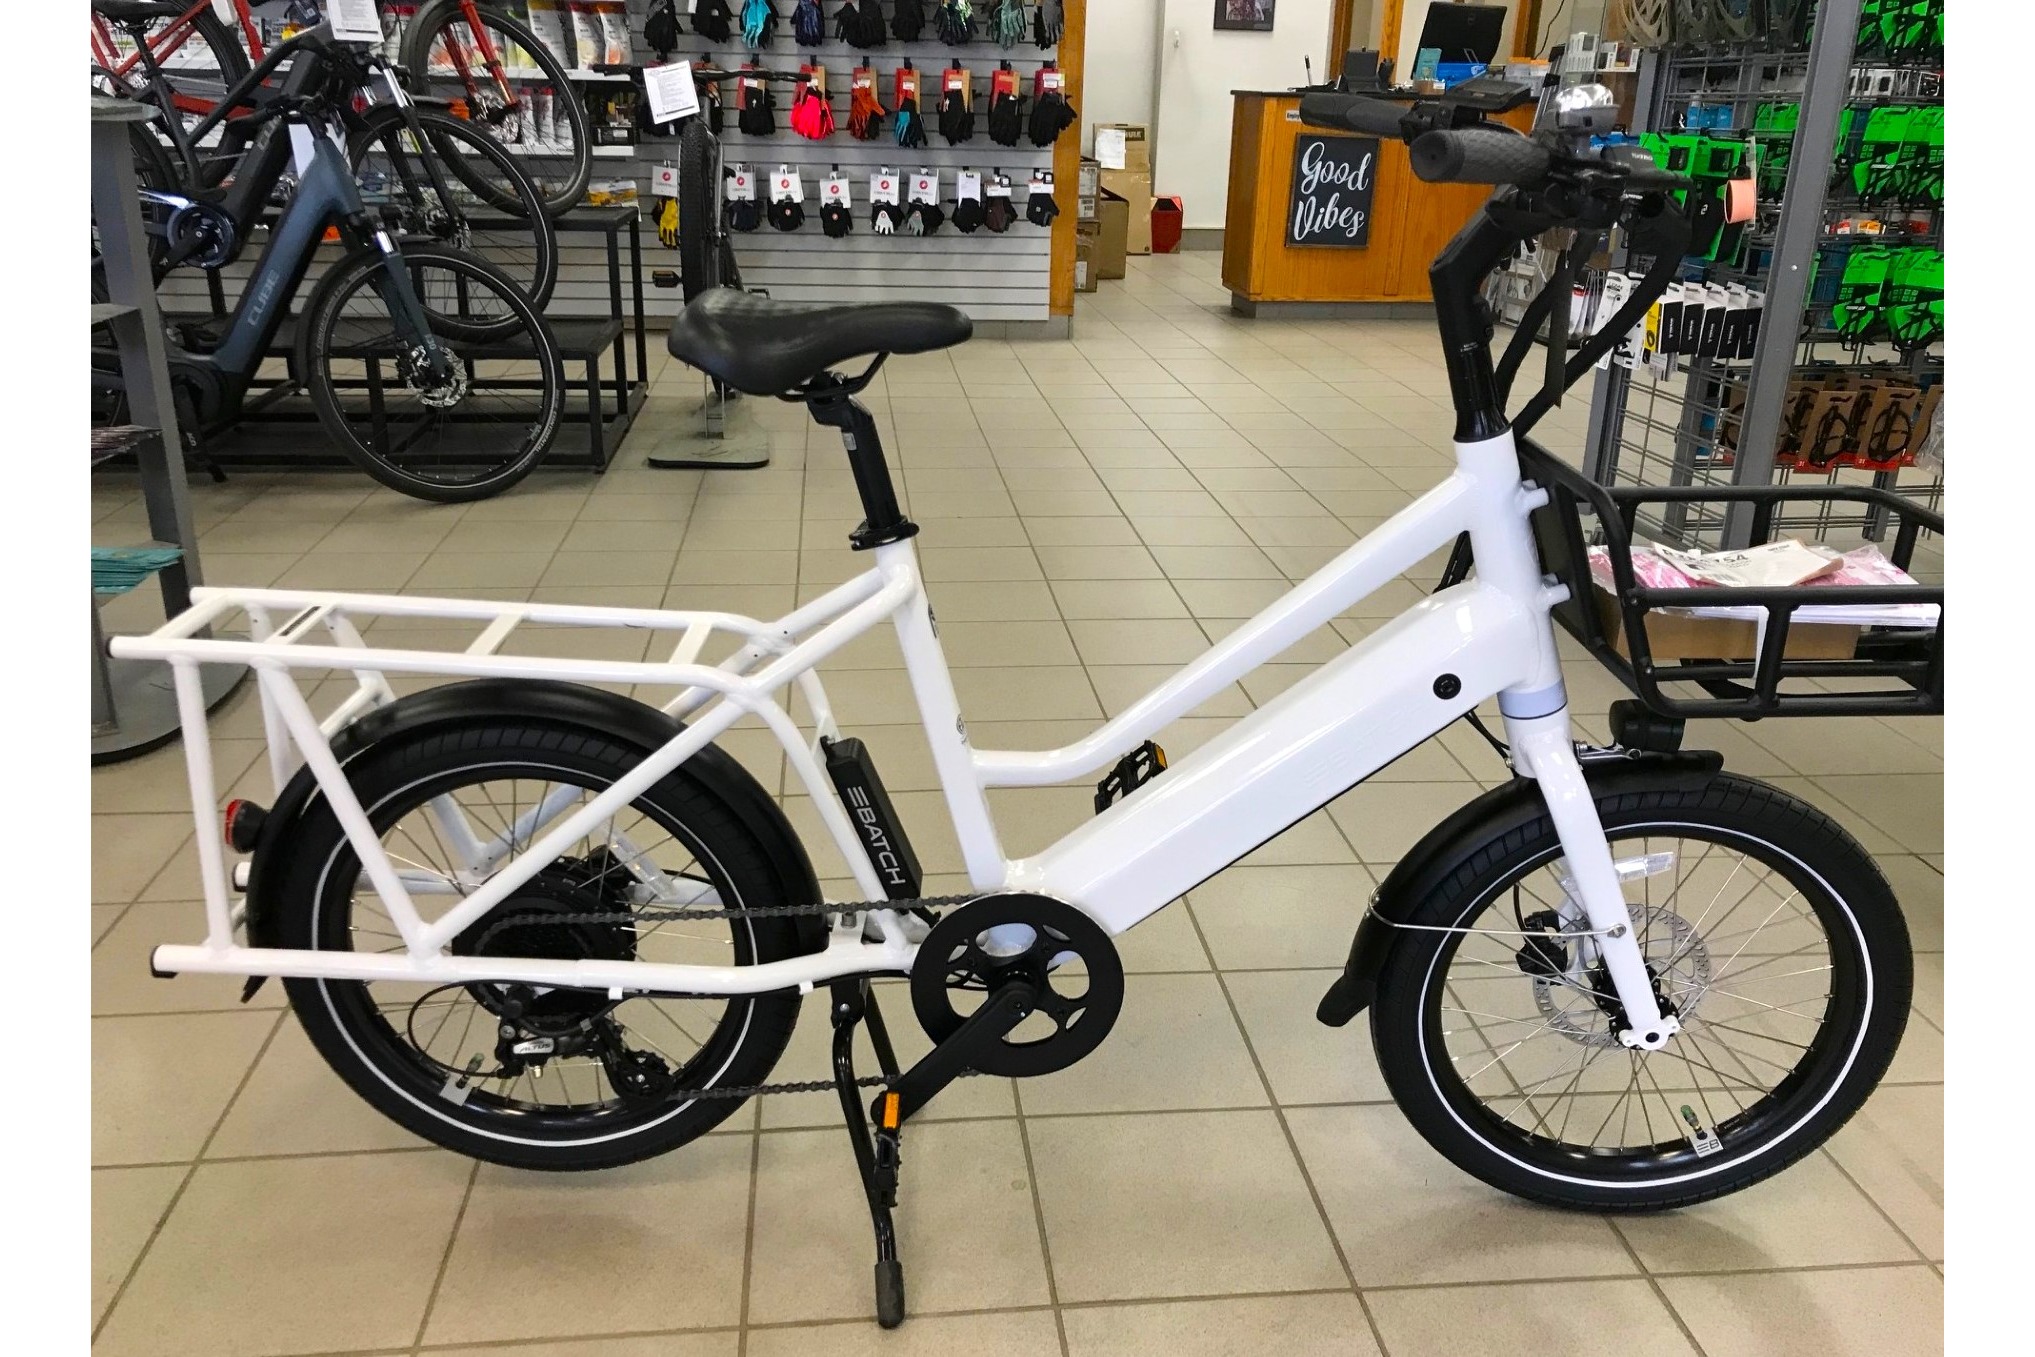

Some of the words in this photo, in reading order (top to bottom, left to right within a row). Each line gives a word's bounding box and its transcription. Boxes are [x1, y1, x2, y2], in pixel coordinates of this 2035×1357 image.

[1300, 141, 1372, 195] Good
[1293, 192, 1366, 242] Vibes
[247, 269, 281, 327] CUBE
[519, 1043, 551, 1052] ALTUS
